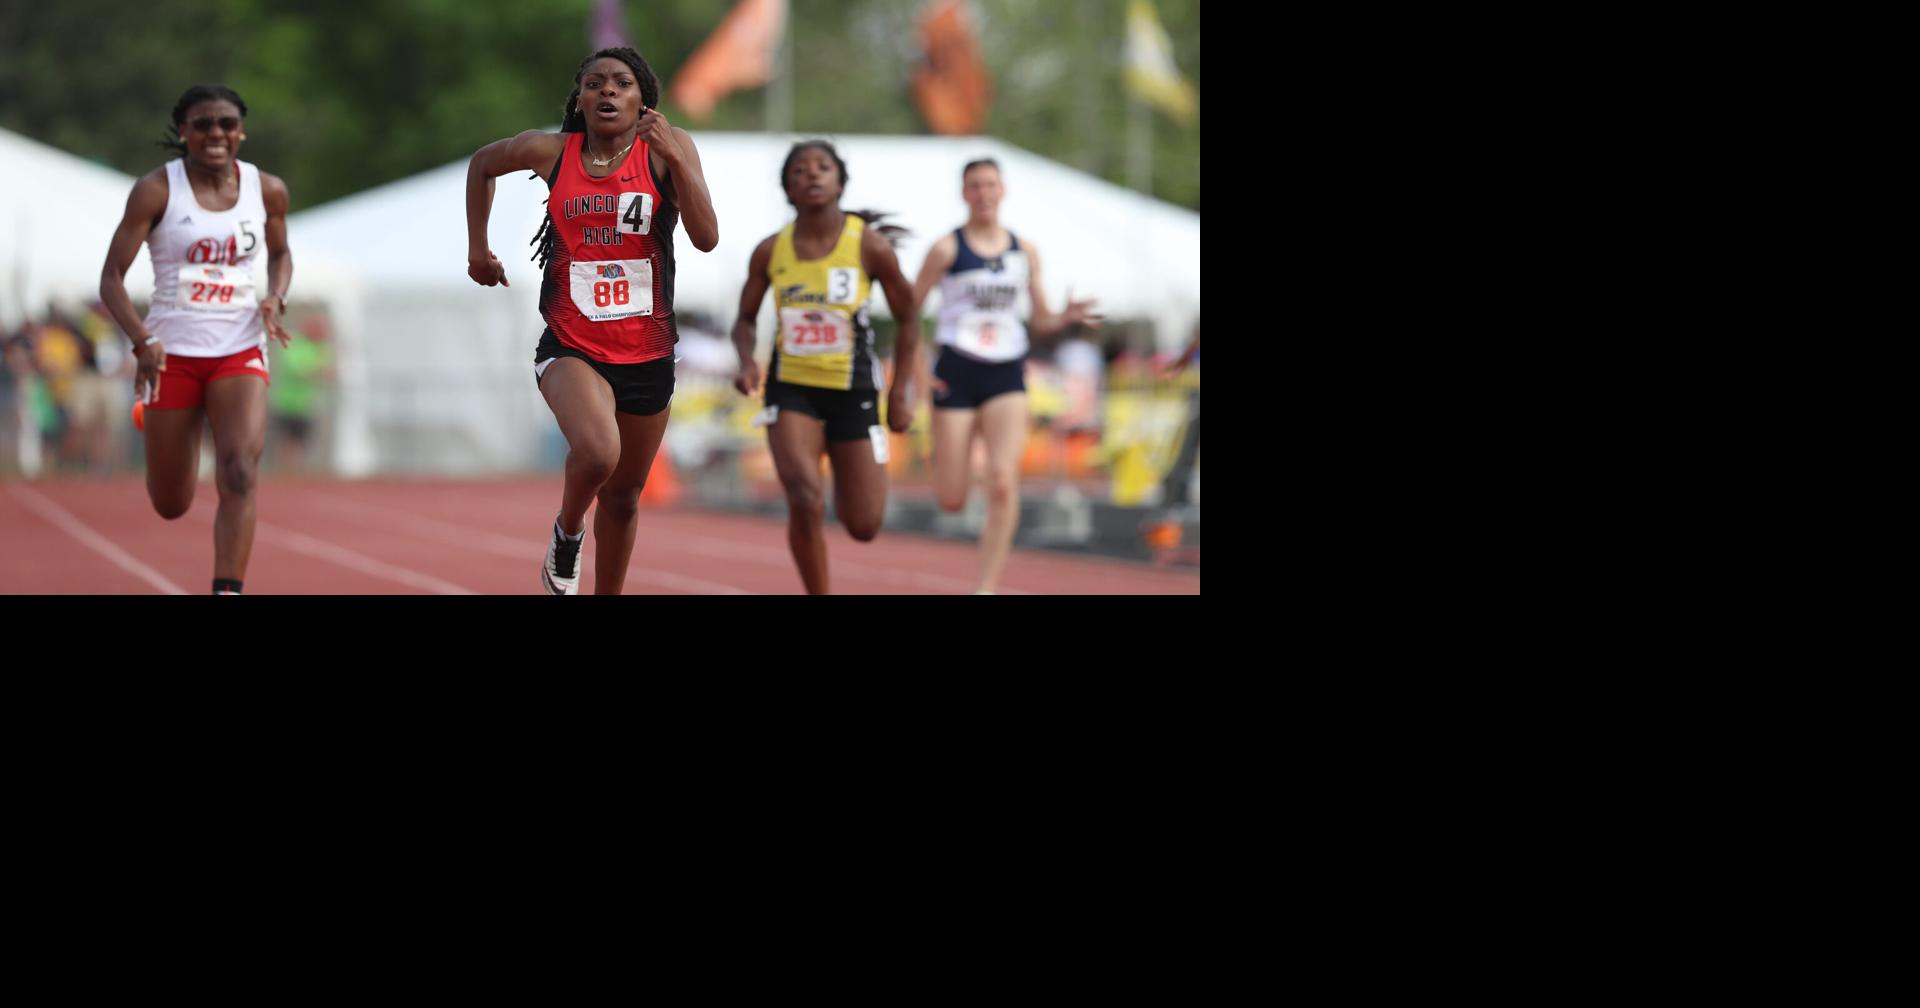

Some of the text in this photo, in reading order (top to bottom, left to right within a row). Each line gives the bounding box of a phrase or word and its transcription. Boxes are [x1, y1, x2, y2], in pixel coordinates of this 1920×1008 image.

[565, 194, 621, 219] LINCO
[622, 194, 643, 232] 4
[239, 220, 256, 252] 5
[583, 226, 623, 245] HIGH
[593, 279, 630, 308] 88
[834, 269, 850, 301] 3
